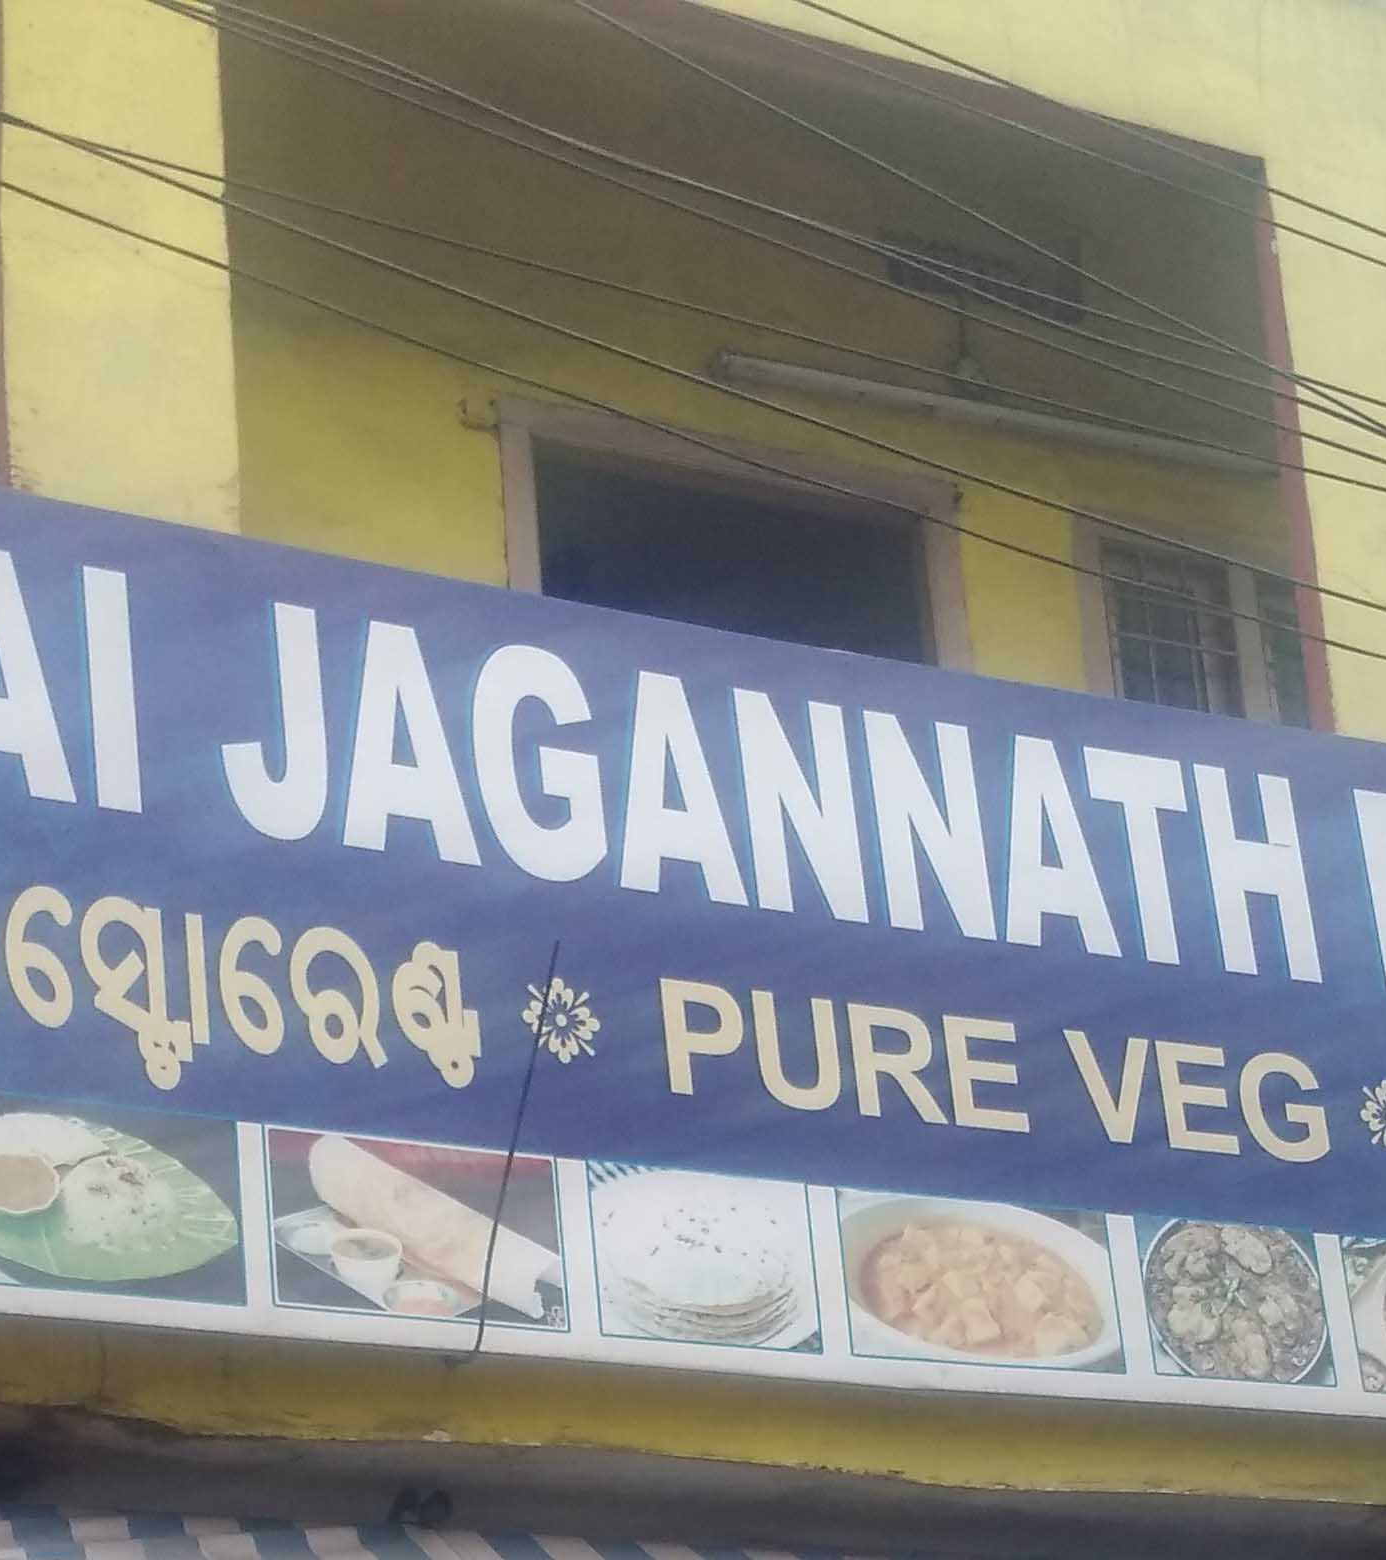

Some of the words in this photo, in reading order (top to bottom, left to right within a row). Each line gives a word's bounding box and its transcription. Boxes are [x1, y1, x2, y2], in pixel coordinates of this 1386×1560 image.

[221, 602, 1323, 983] JAGANNATH
[659, 978, 1030, 1134] PURE
[1064, 1029, 1329, 1163] VEG
